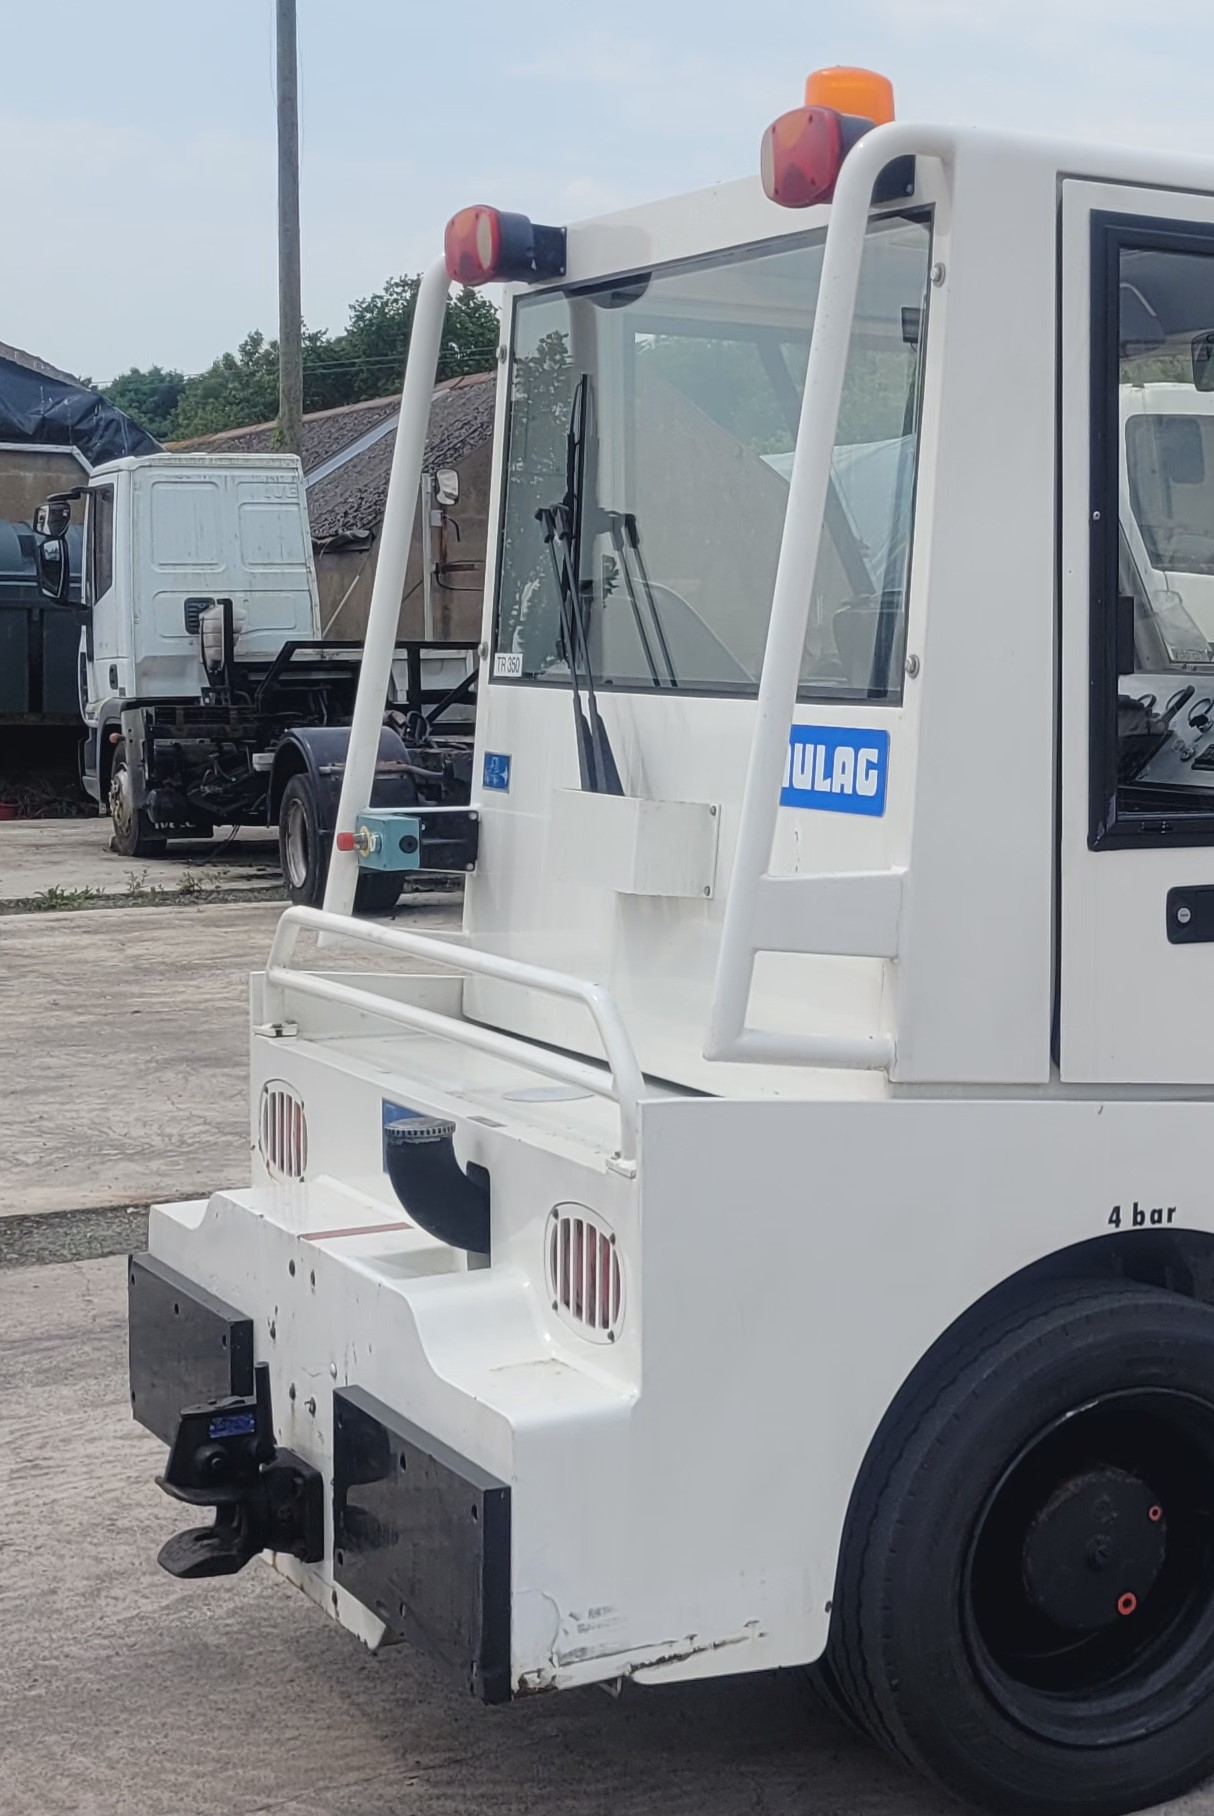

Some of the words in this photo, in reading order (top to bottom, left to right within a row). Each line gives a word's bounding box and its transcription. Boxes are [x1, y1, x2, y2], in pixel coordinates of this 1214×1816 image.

[496, 656, 507, 673] TR
[507, 656, 521, 673] 350
[1108, 1205, 1122, 1228] 4
[1132, 1202, 1177, 1227] bar
